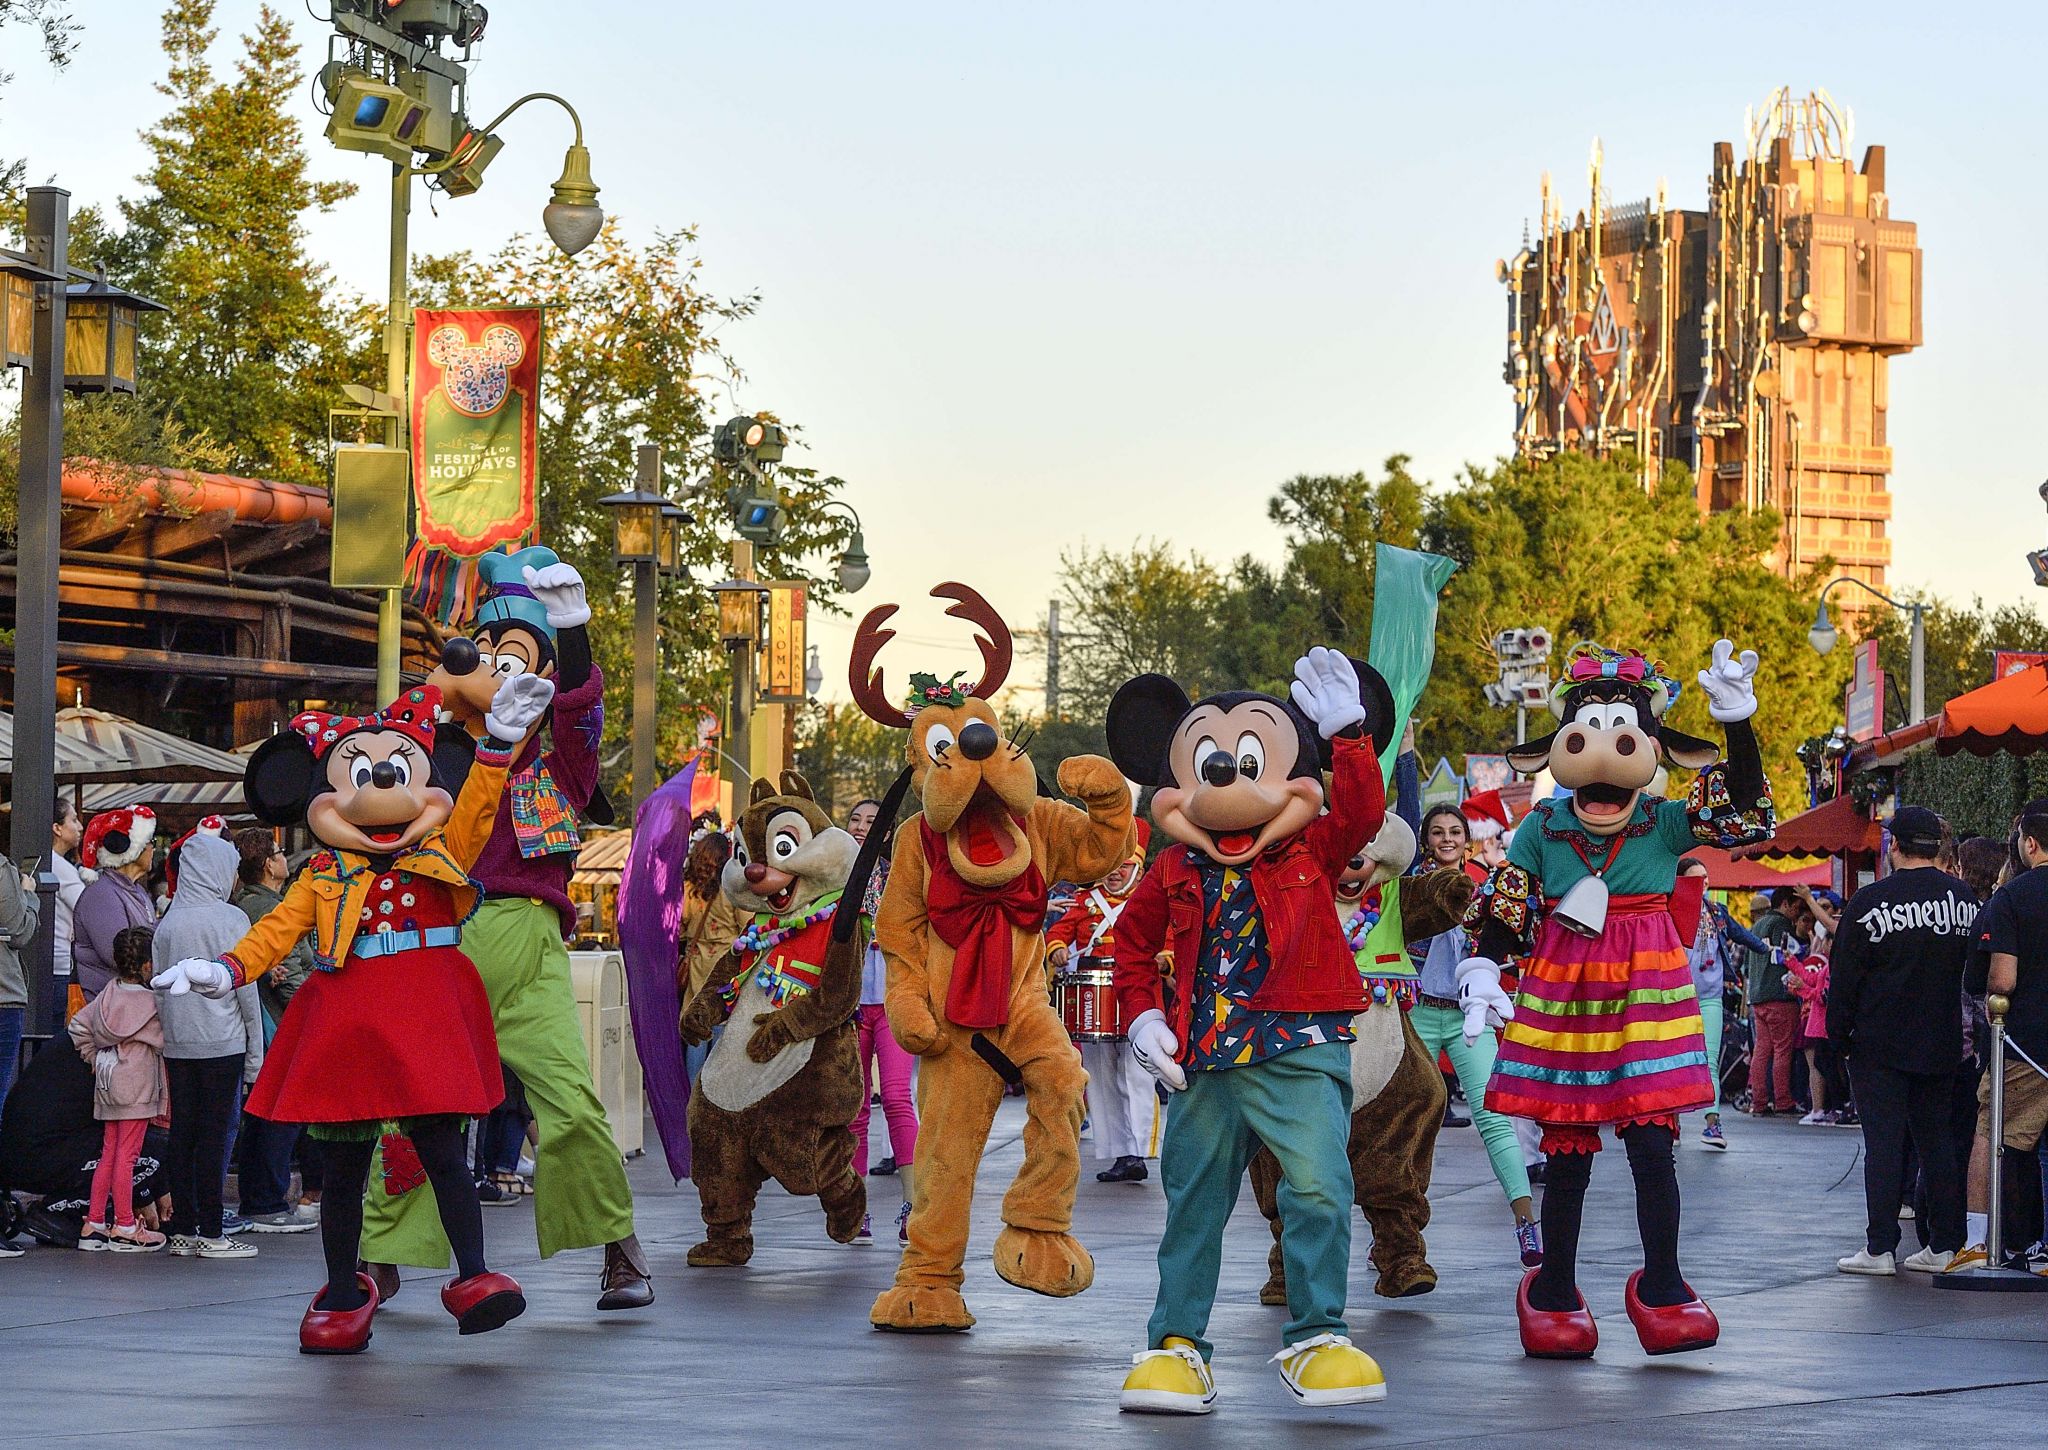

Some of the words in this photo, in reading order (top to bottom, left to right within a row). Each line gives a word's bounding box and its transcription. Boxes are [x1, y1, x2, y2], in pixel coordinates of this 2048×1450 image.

[498, 446, 511, 454] OF
[776, 597, 787, 680] SONOMA
[1856, 889, 1984, 943] Disneylan
[1084, 1000, 1093, 1031] YAMAHA
